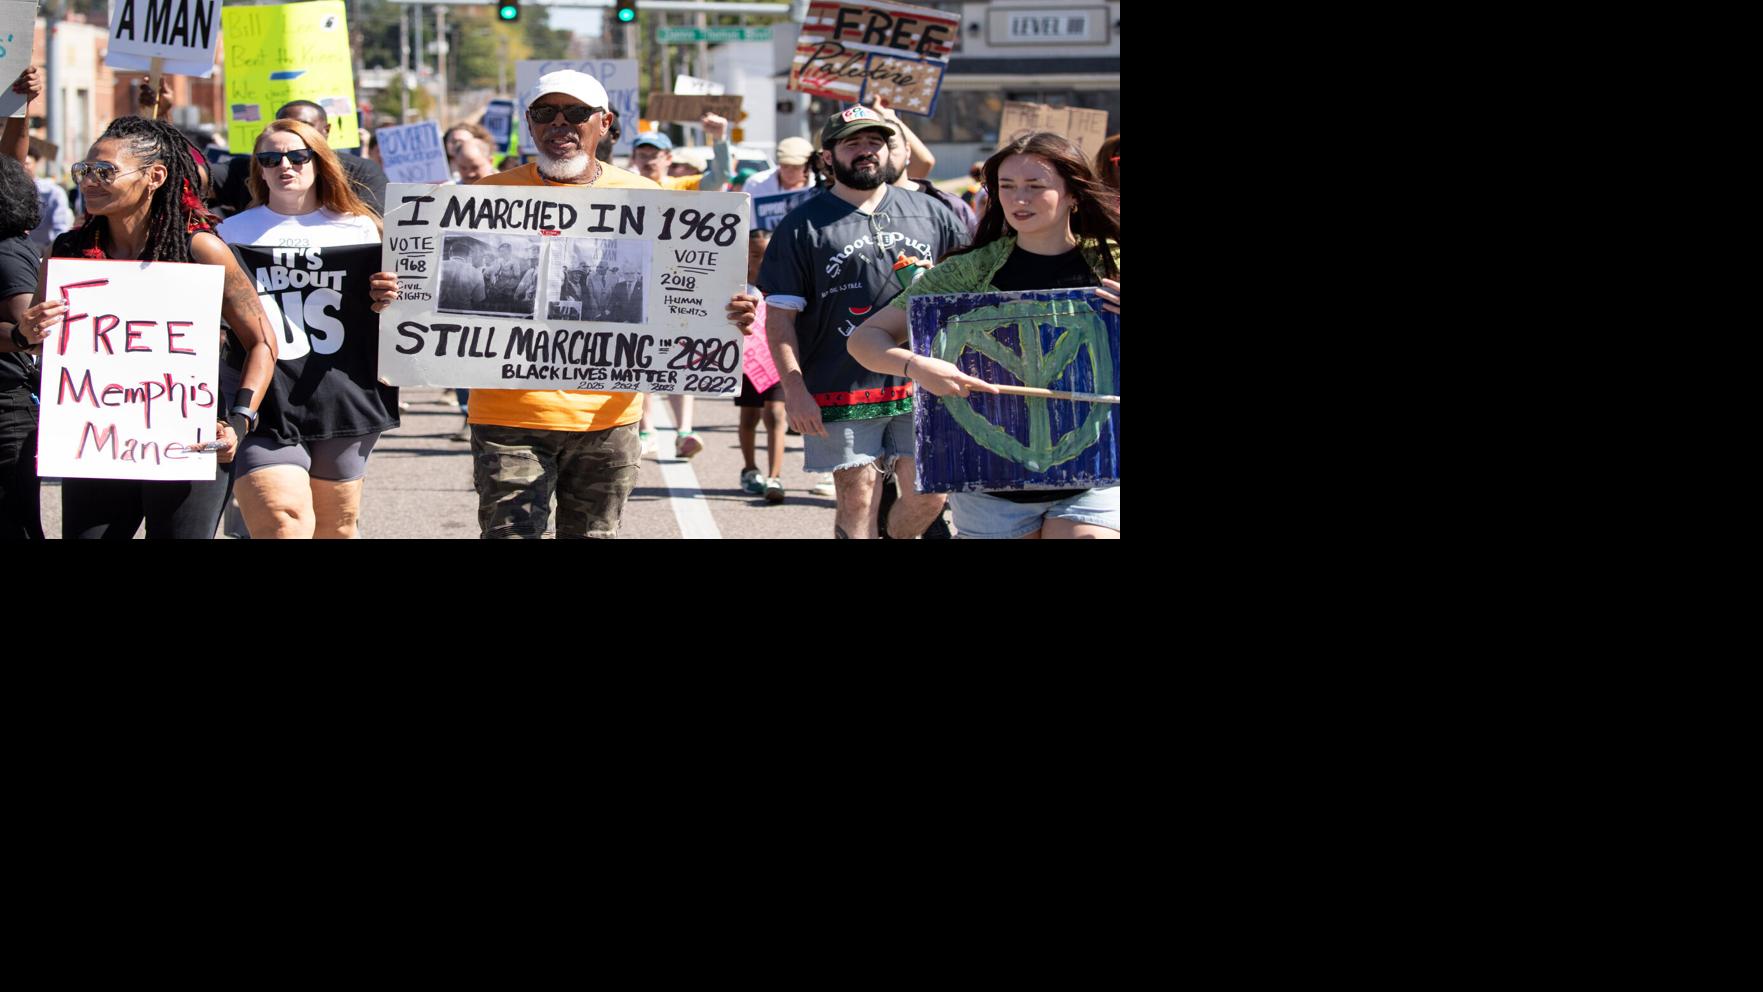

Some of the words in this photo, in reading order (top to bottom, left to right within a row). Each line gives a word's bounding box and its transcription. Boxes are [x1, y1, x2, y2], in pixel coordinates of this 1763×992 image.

[116, 0, 135, 40] A
[144, 0, 214, 49] MAN
[833, 7, 949, 58] FREE
[799, 41, 917, 87] Palestine
[397, 196, 435, 226] I
[439, 195, 577, 230] MARCHED
[587, 204, 646, 235] IN
[657, 207, 741, 247] 1968
[279, 238, 310, 247] 2023
[390, 236, 434, 251] VOTE
[272, 247, 323, 270] IT'S
[395, 259, 427, 273] 1968
[674, 249, 719, 266] VOTE
[256, 265, 347, 292] ABOUT
[660, 273, 696, 290] 2018
[664, 295, 703, 306] HUMAN
[669, 305, 708, 317] RIGHTS
[57, 277, 197, 356] FREE
[258, 287, 345, 360] US
[395, 321, 498, 358] STILL
[504, 326, 654, 369] MARCHING
[659, 338, 672, 347] IN
[666, 336, 740, 374] 2020
[502, 364, 560, 380] BLACK
[562, 367, 608, 381] LIVES
[610, 367, 678, 384] MATTER
[684, 374, 737, 393] 2022
[577, 382, 604, 390] 2025
[57, 367, 215, 429] Memphis
